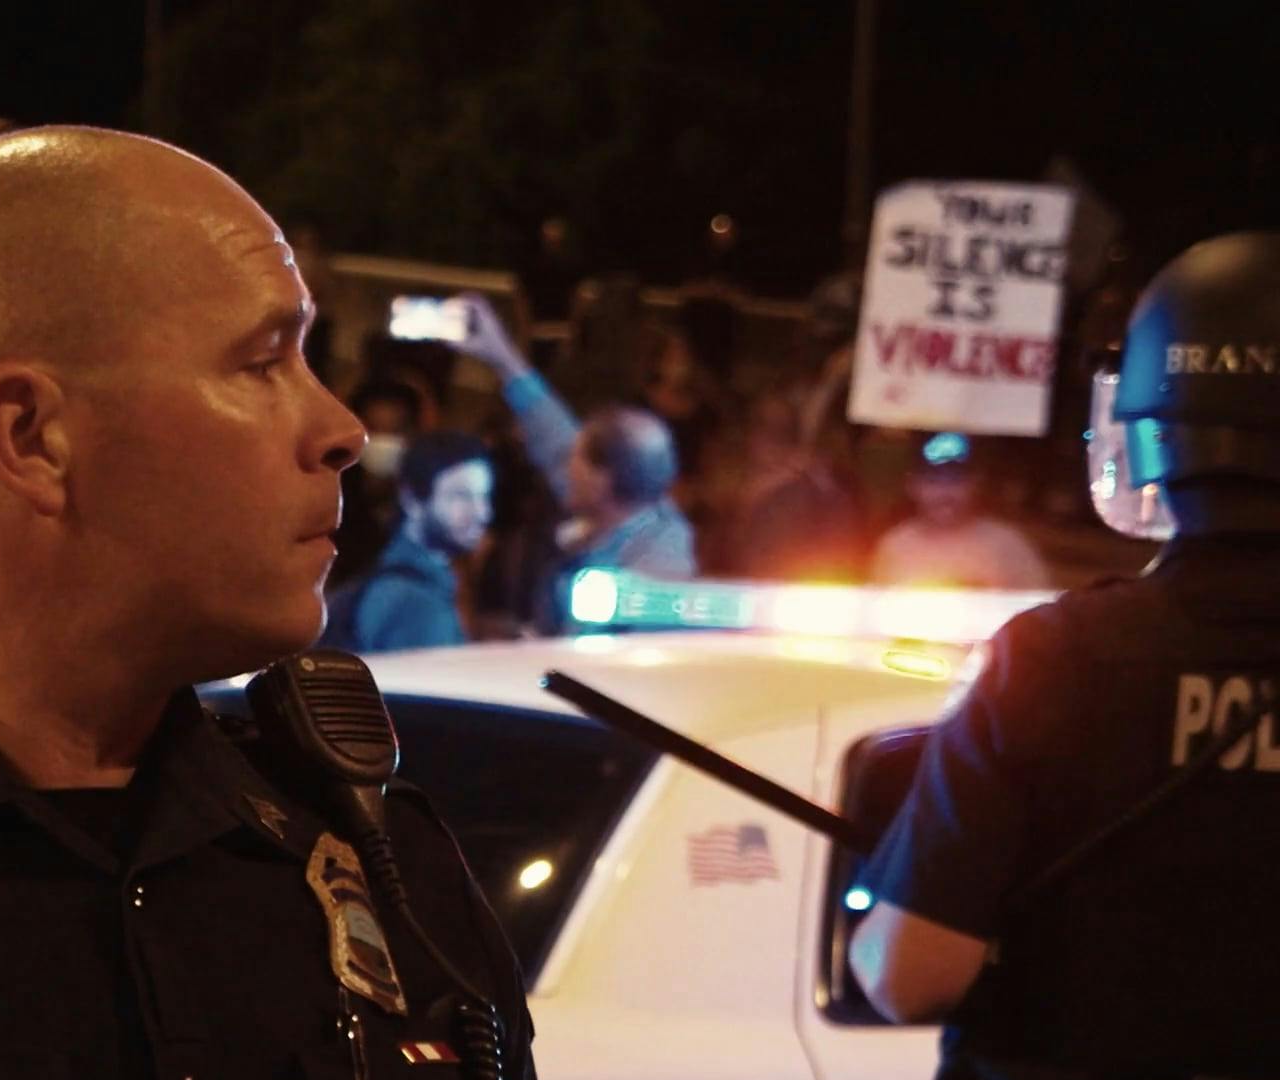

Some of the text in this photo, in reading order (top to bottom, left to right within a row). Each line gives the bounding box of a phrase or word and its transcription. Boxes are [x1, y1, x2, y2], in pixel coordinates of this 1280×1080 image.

[928, 279, 996, 320] IS
[871, 324, 1056, 385] VIOLENCE
[1165, 343, 1276, 374] BRAN
[1171, 672, 1280, 772] POL
